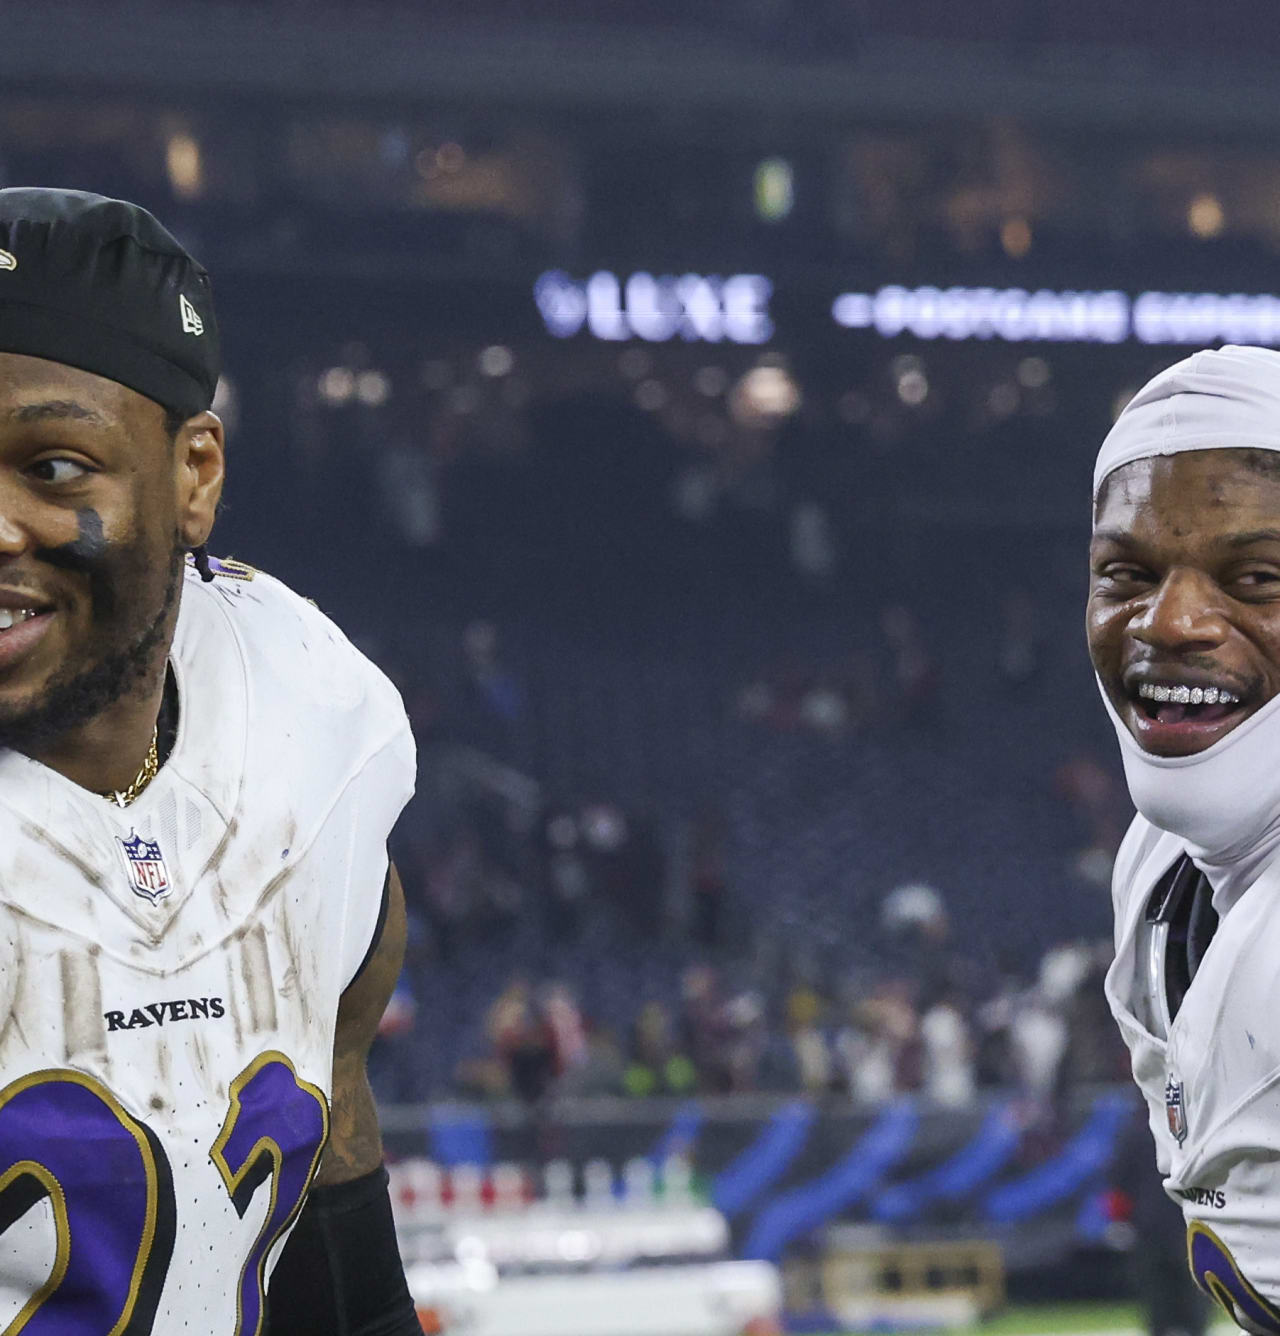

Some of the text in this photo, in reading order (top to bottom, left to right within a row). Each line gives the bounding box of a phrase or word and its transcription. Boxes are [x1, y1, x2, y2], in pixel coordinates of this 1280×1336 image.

[872, 284, 1129, 343] POSTGAME
[133, 860, 167, 890] NFL
[104, 997, 226, 1032] RAVENS
